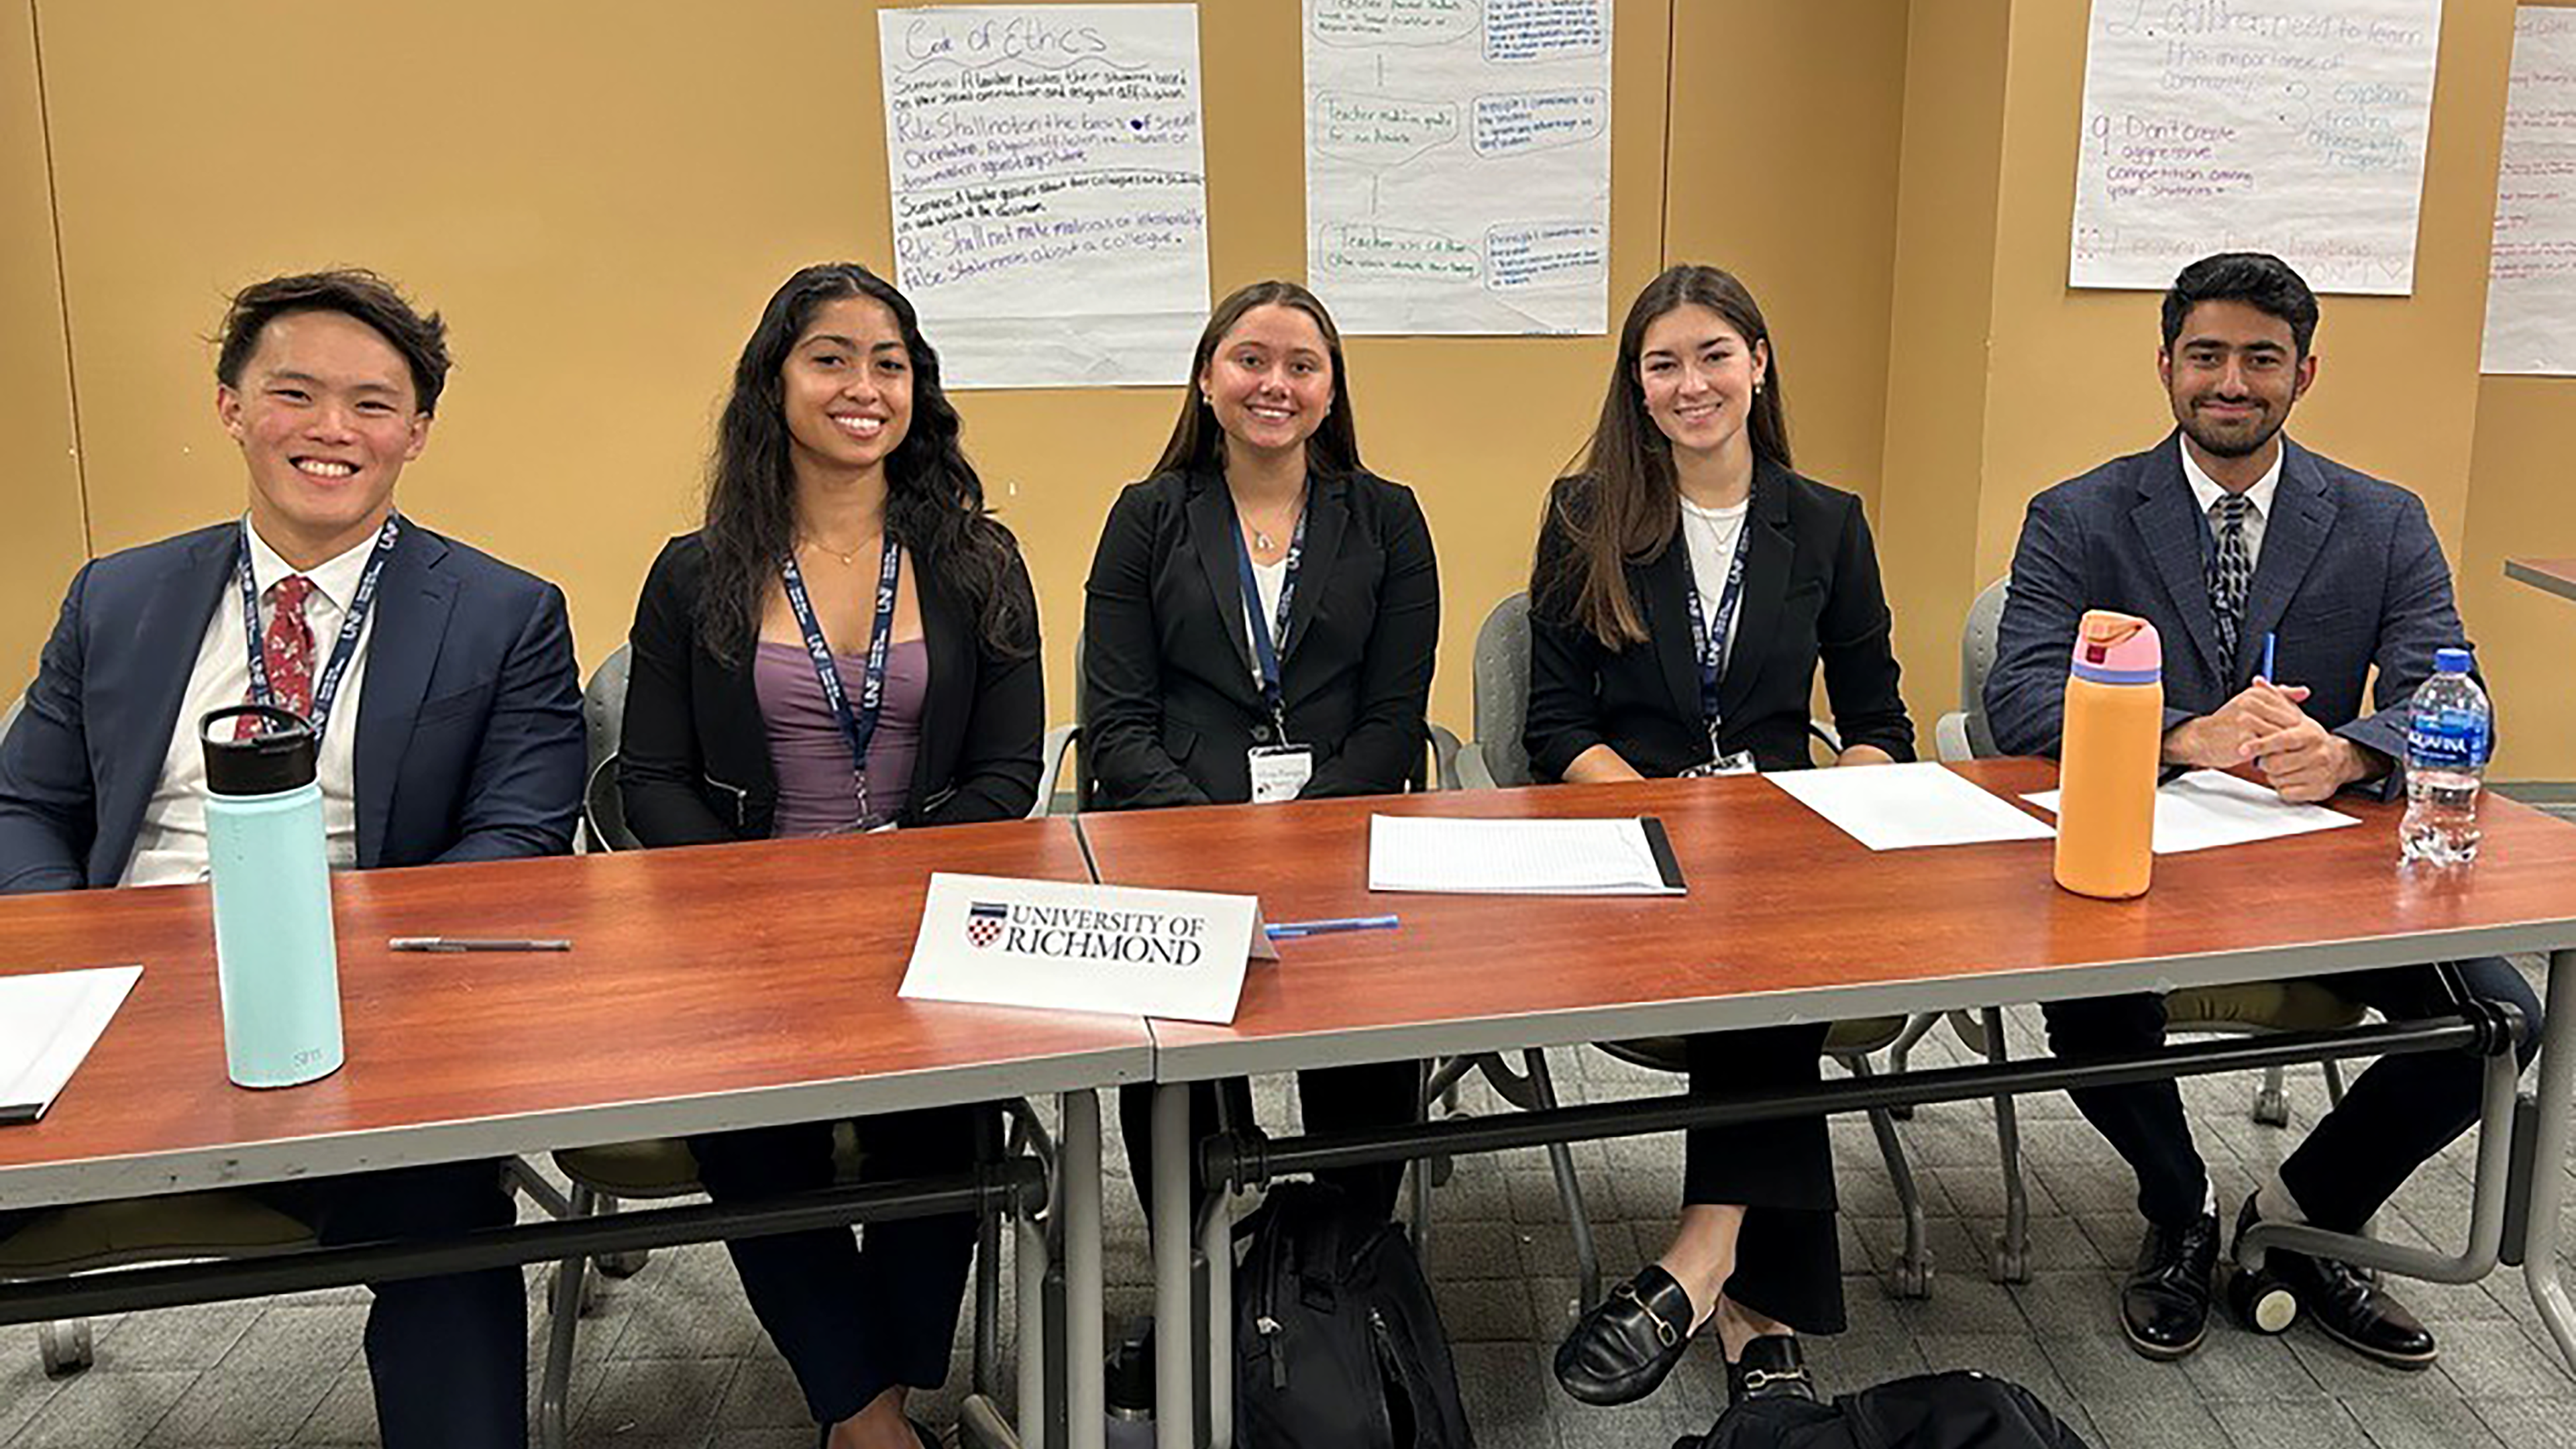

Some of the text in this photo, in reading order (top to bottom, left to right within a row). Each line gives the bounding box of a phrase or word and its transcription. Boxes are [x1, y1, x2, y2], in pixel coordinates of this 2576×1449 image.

[969, 17, 990, 51] of
[1004, 17, 1107, 58] Ethics
[2339, 17, 2361, 38] to
[2183, 125, 2237, 142] create
[2122, 145, 2212, 166] aggressive
[2106, 166, 2203, 183] competition
[2106, 185, 2140, 202] your
[1083, 241, 1096, 252] a
[1012, 903, 1205, 939] UNIVERSITY OF
[1005, 926, 1202, 967] RICHMOND
